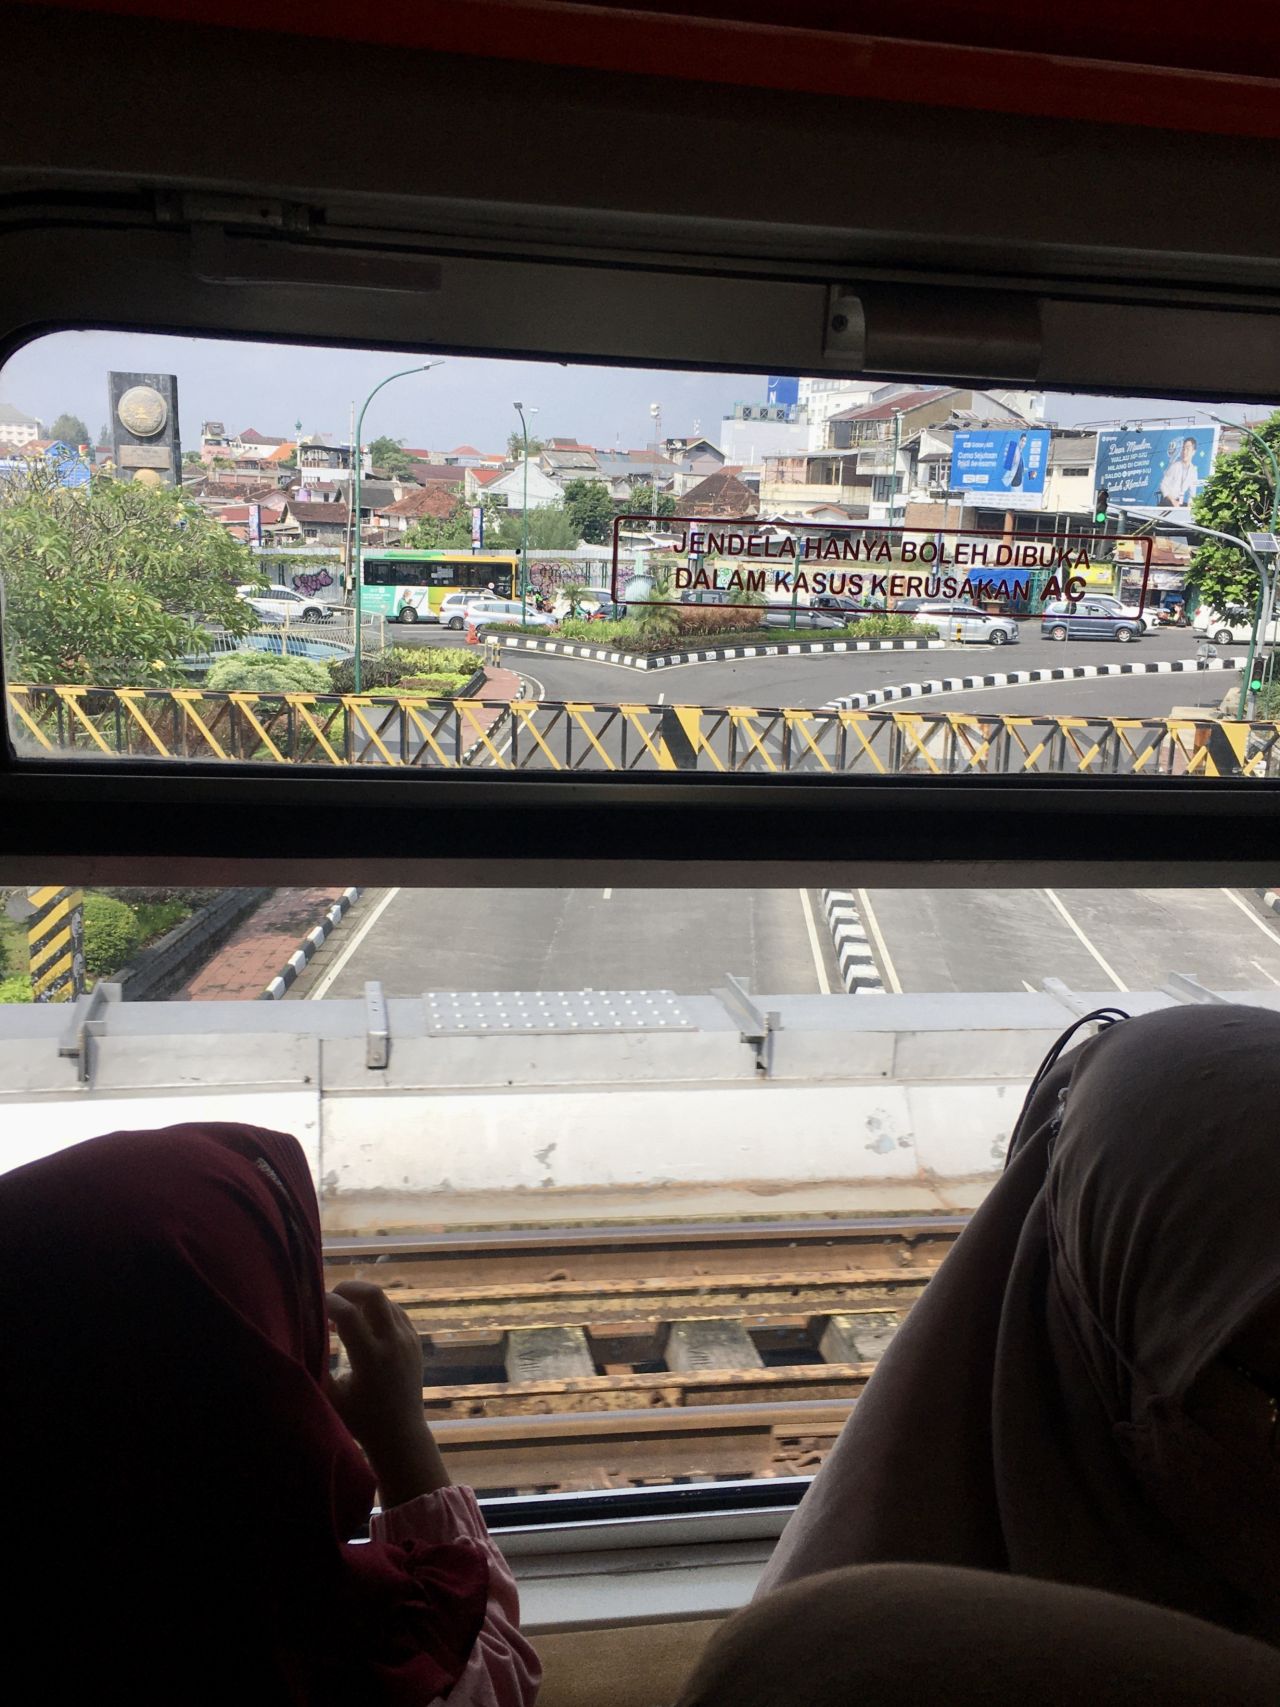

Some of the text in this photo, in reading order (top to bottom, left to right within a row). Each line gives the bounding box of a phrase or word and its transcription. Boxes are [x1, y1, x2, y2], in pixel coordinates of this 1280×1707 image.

[1108, 463, 1127, 471] HILANG
[673, 531, 1091, 570] JENDELA HANYA BOLEH DIBUKA
[675, 567, 766, 592] DALAM
[774, 571, 863, 596] KASUS
[871, 574, 1030, 601] KERUSAKAN
[1040, 576, 1087, 603] AC
